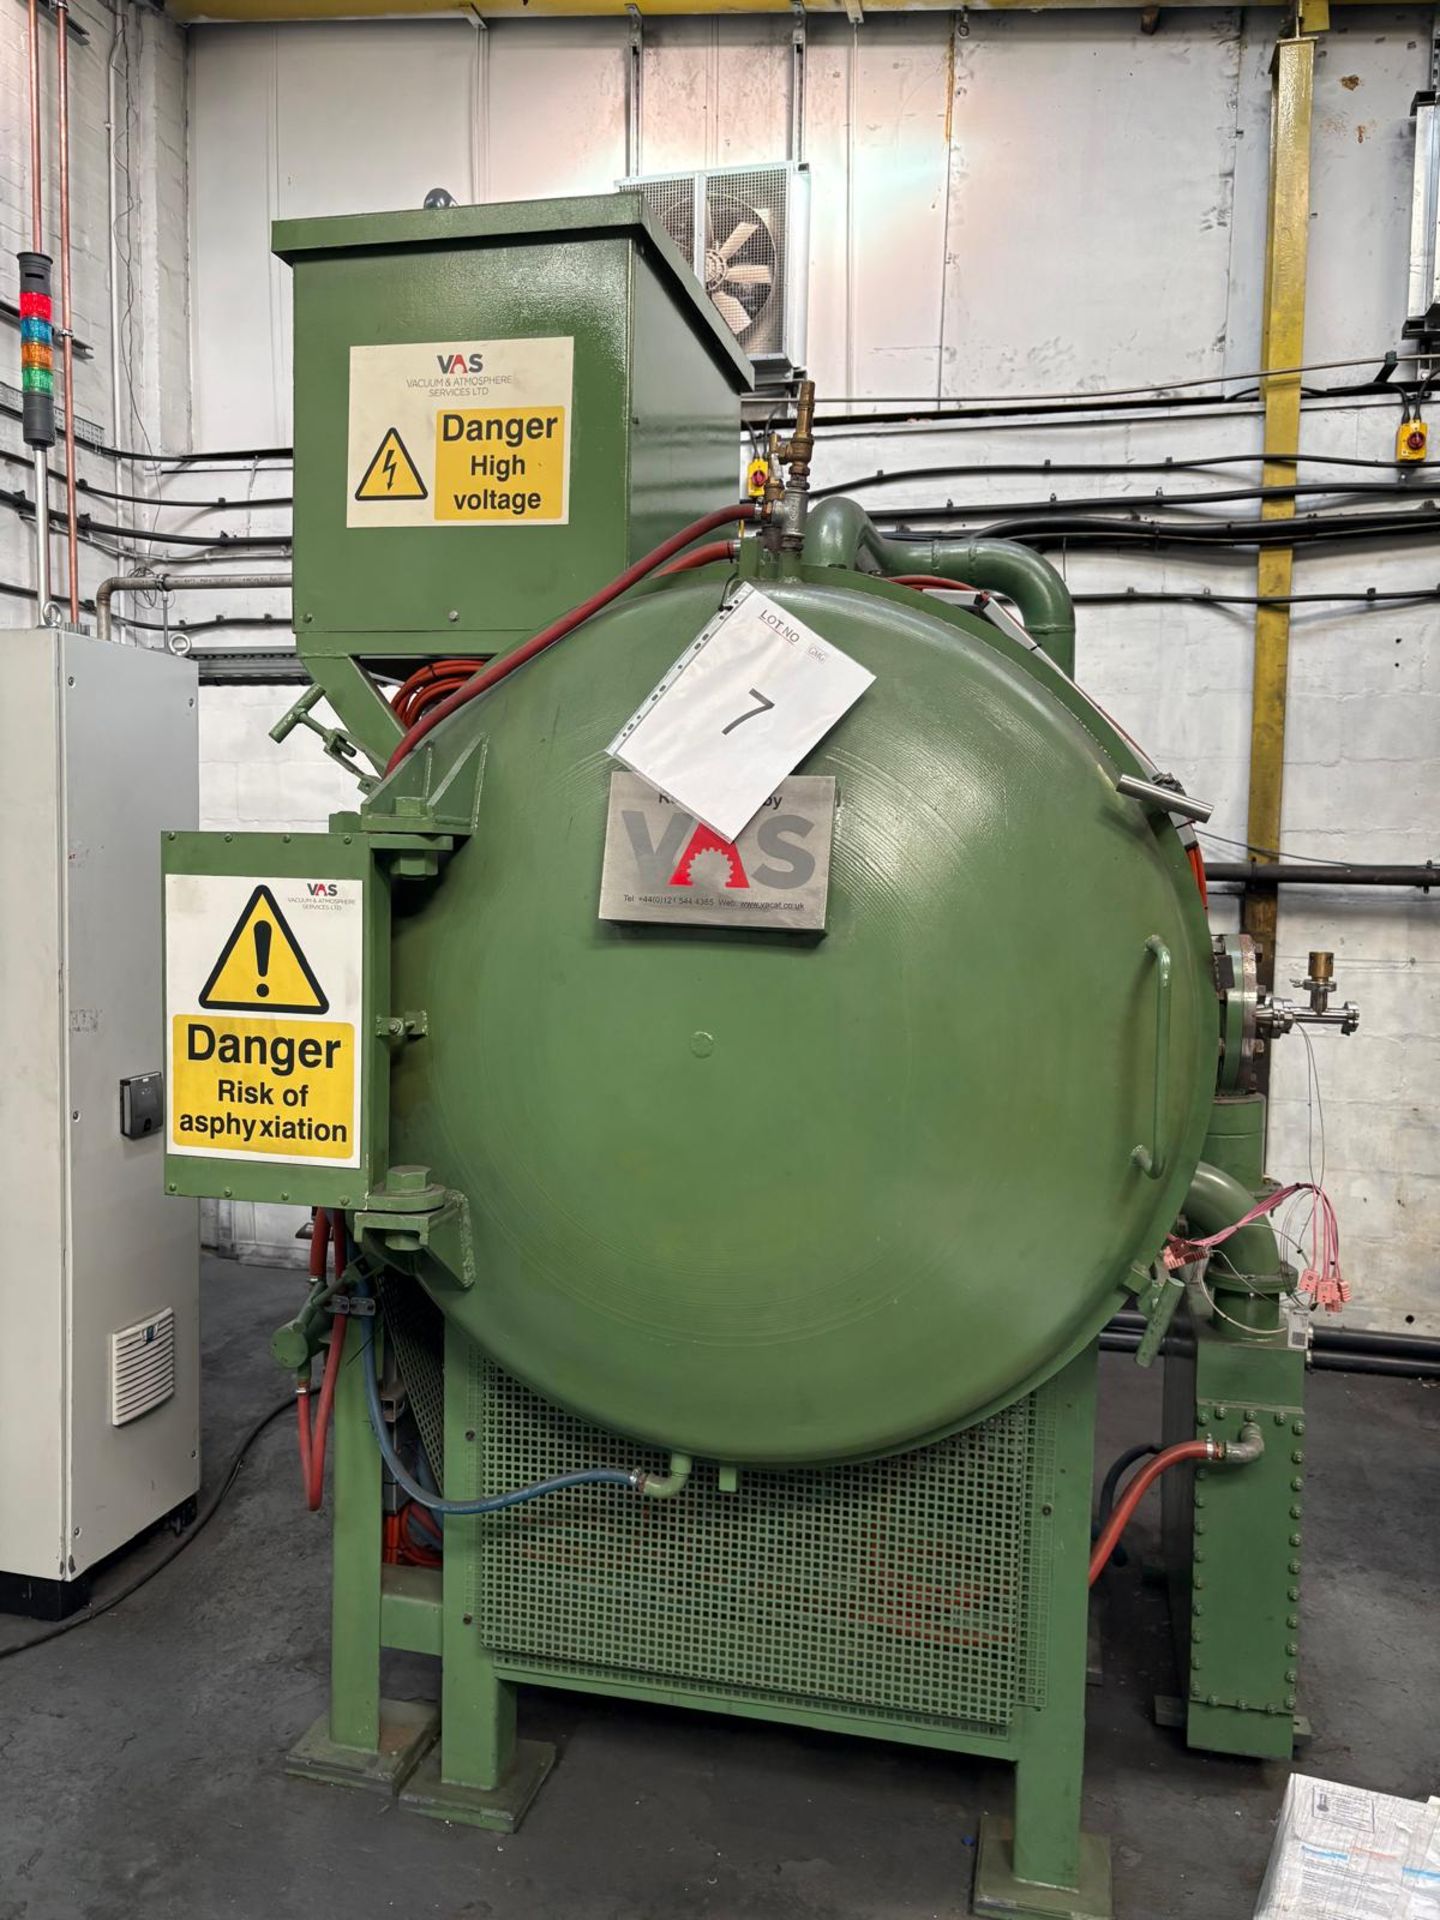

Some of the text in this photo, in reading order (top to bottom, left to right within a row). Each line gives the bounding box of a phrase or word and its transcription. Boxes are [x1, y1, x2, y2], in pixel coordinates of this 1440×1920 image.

[437, 353, 484, 374] VAS
[406, 375, 513, 388] VACUUM & ATMOSPHERE
[429, 386, 489, 397] SERVICES LTD
[442, 413, 558, 447] Danger
[470, 454, 525, 482] High
[453, 489, 542, 515] voltage
[760, 609, 800, 643] LOT NO
[721, 688, 775, 735] 7
[621, 810, 817, 890] VAS
[307, 883, 338, 897] VAS
[187, 1023, 341, 1076] Danger
[218, 1079, 308, 1107] Risk of
[179, 1111, 347, 1143] asphyxiation
